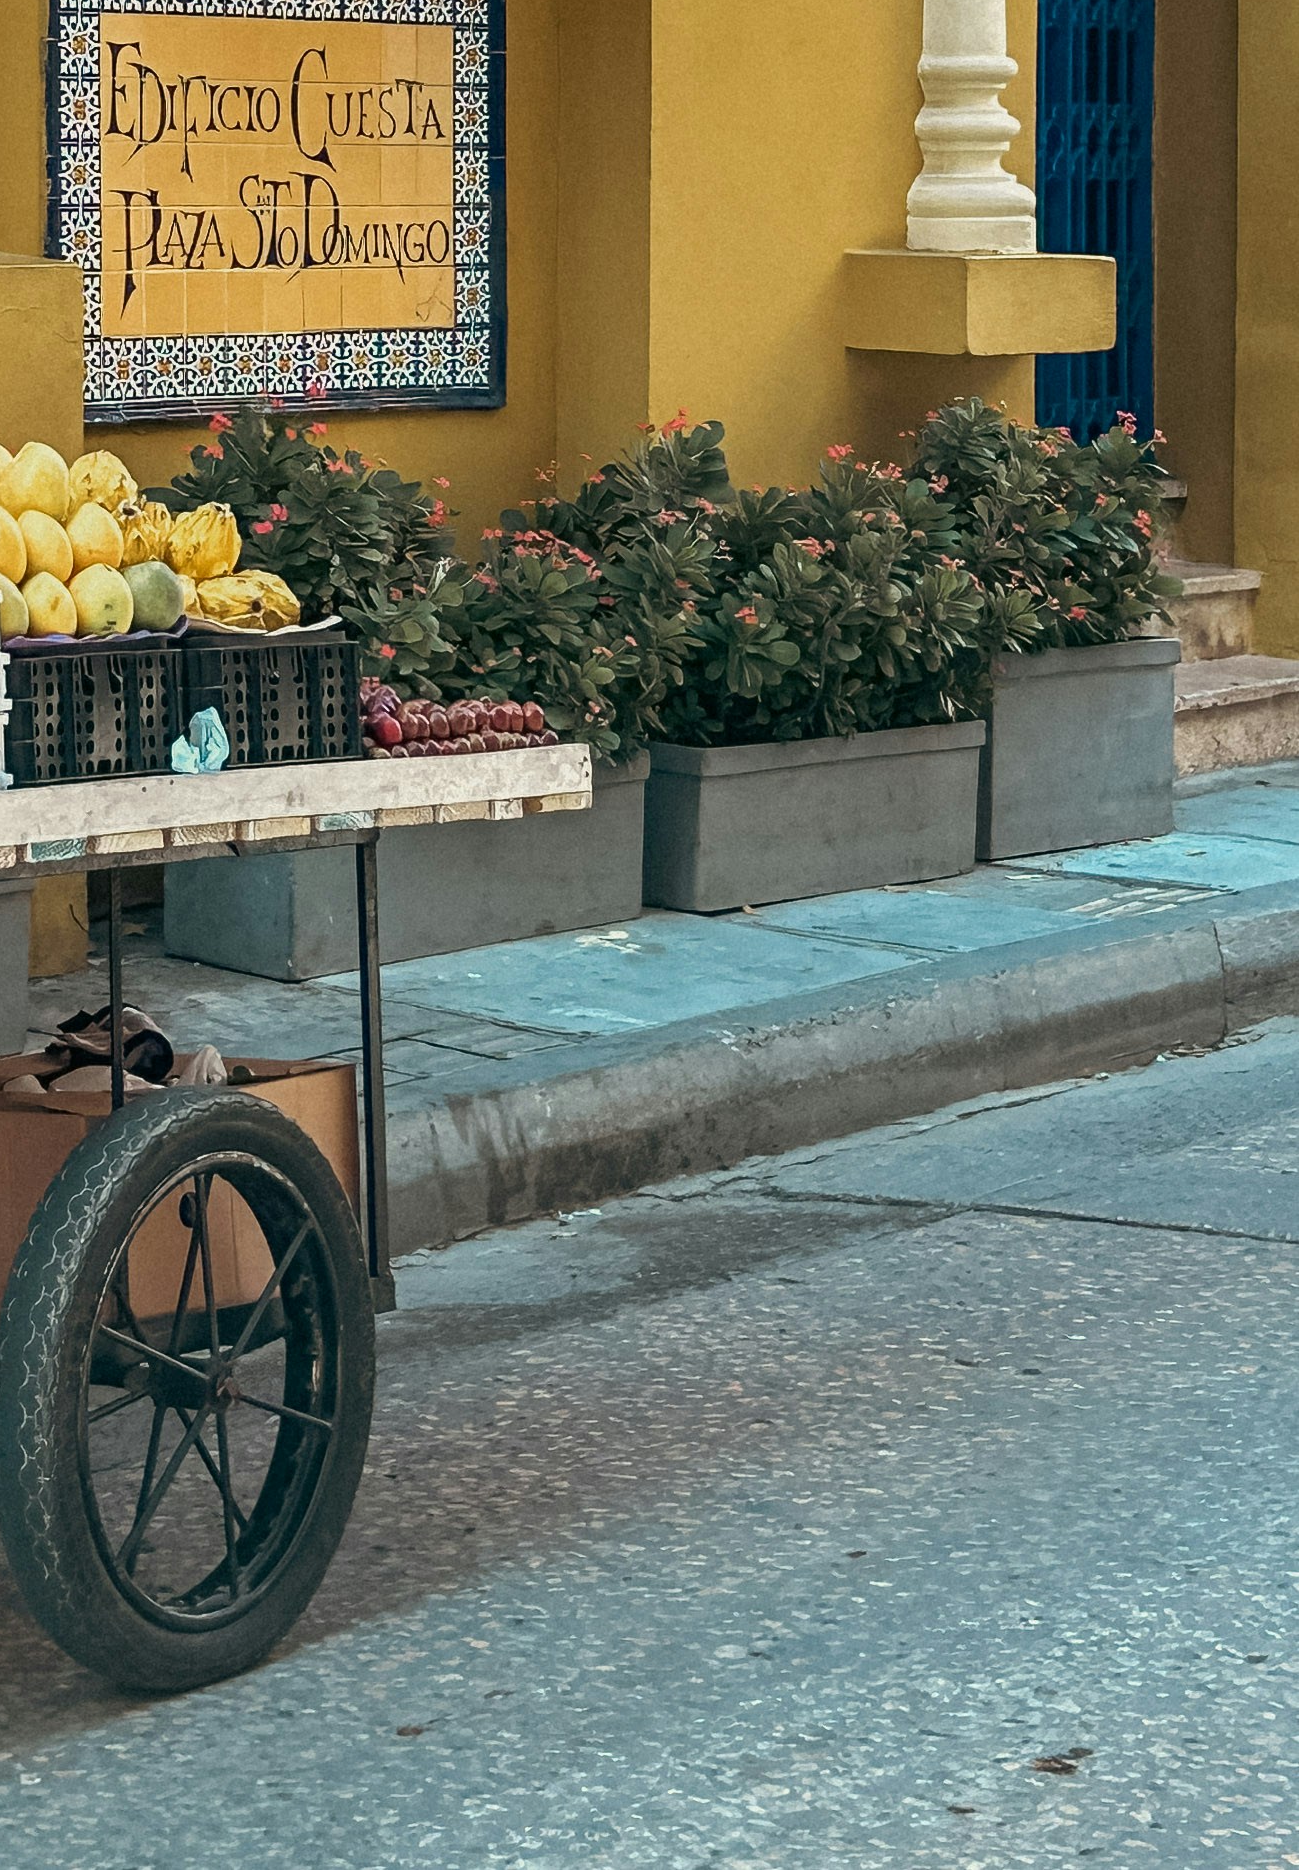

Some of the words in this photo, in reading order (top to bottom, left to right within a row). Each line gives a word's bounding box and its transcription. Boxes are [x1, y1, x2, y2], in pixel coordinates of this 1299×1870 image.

[104, 42, 281, 183] EDIFICIO
[291, 45, 446, 173] CUESTA
[109, 188, 226, 320] PLAZA
[288, 172, 450, 285] DOMINGO
